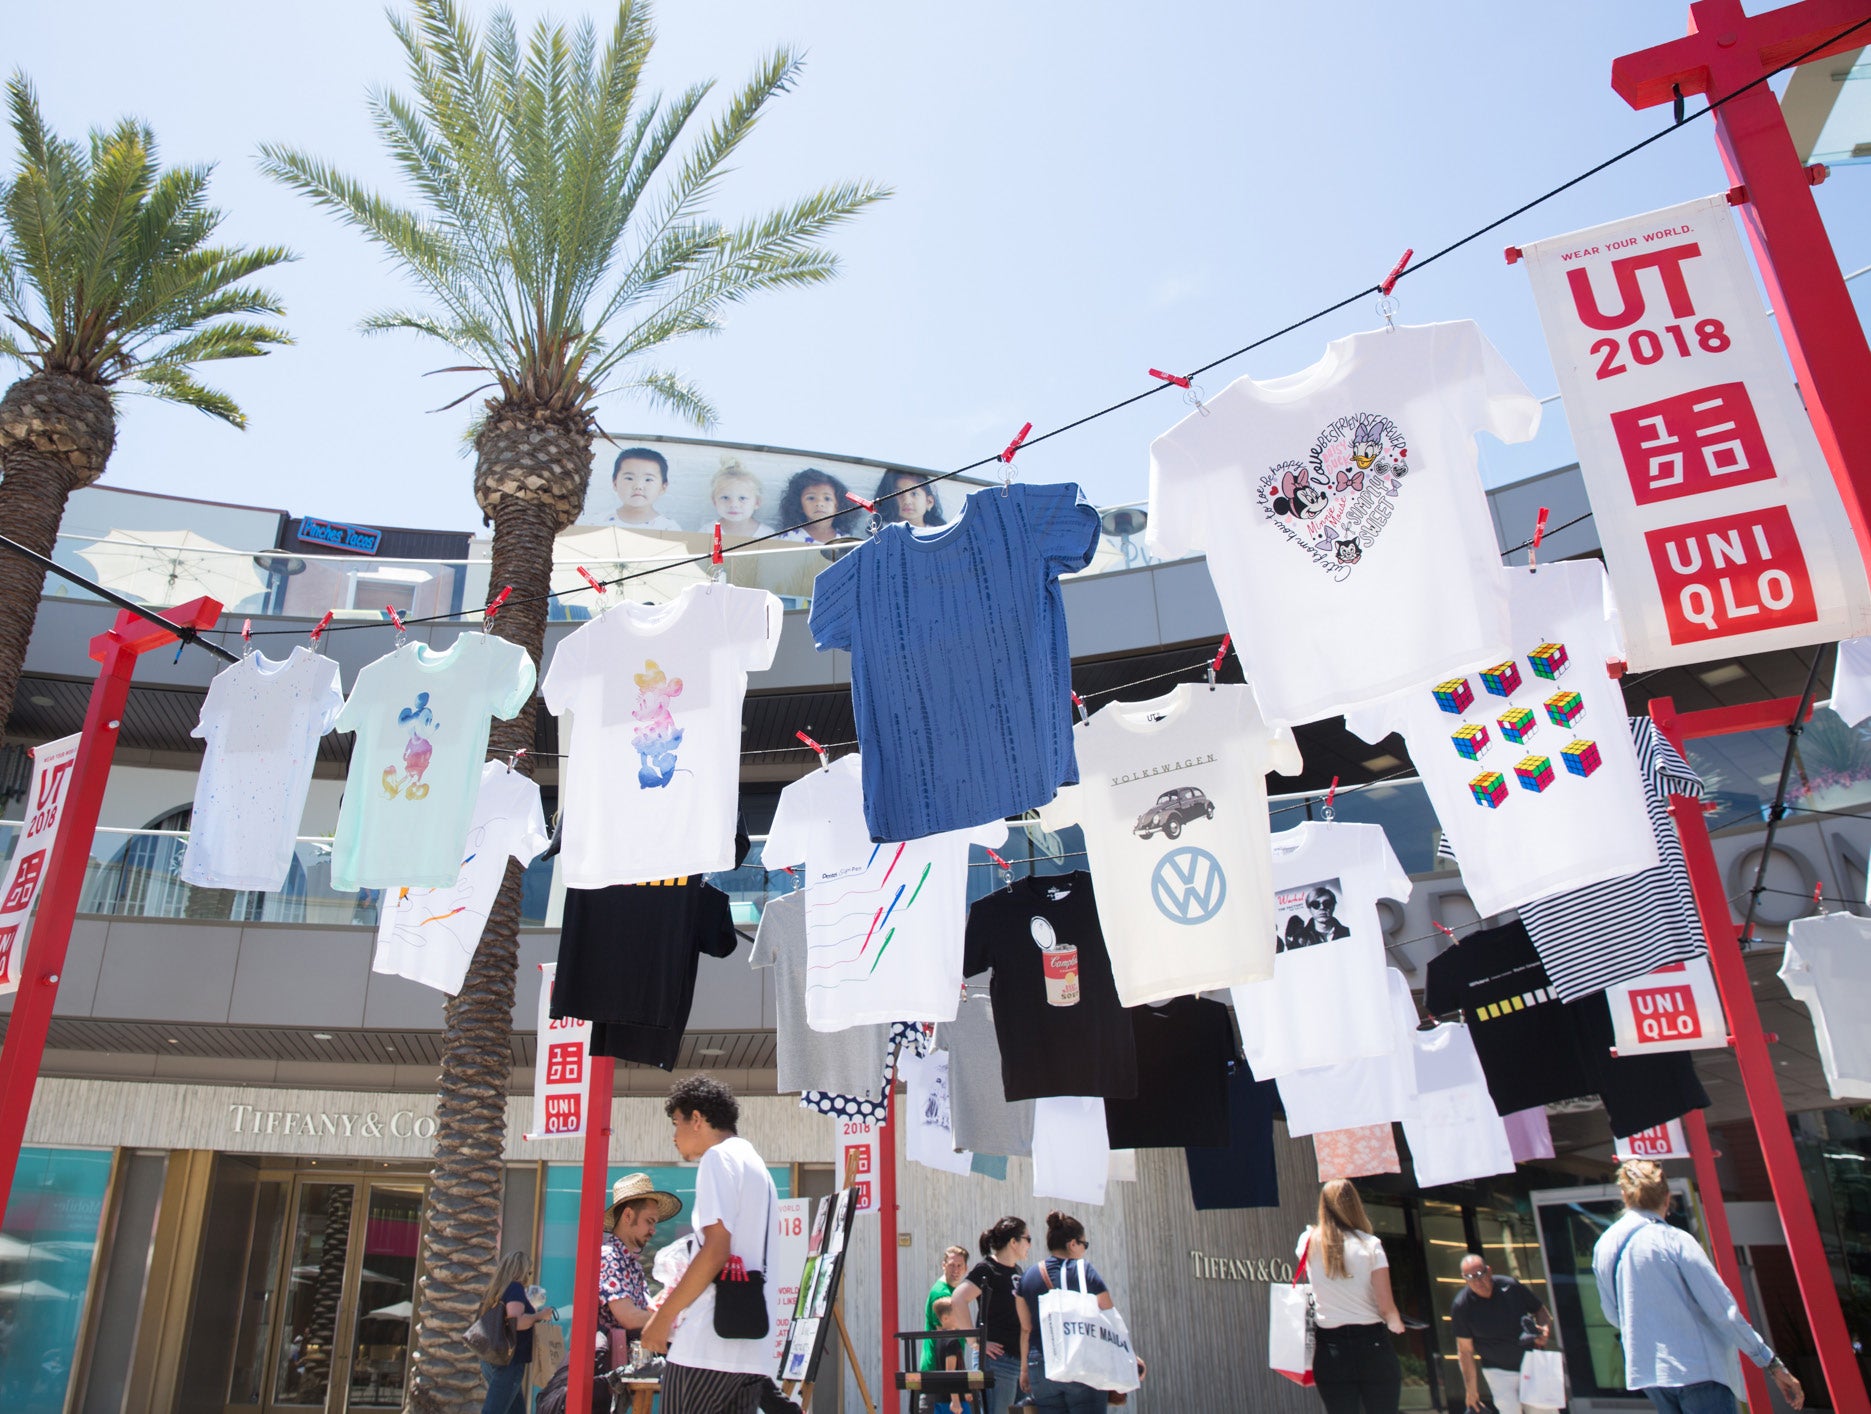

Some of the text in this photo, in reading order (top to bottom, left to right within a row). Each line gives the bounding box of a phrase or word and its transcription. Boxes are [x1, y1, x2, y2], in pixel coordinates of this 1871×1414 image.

[1561, 225, 1695, 261] WEAR YOUR WORLD.
[1566, 242, 1702, 331] UT
[1589, 318, 1731, 381] 2018
[1345, 475, 1389, 526] SIMPLY
[304, 520, 375, 549] Pinches Tacos
[1359, 496, 1395, 548] SWEET
[1665, 524, 1772, 575] UNI
[1679, 568, 1795, 631] QLO
[37, 758, 75, 811] UT
[1111, 753, 1216, 786] VOLKSWAGEN
[27, 805, 58, 839] 2018
[0, 931, 15, 953] NI
[1636, 992, 1685, 1015] UNI
[1642, 1015, 1694, 1040] QLO
[548, 1098, 575, 1114] UNI
[548, 1115, 578, 1134] QLO
[1634, 1139, 1668, 1156] QLO
[1063, 1321, 1097, 1338] STEVE
